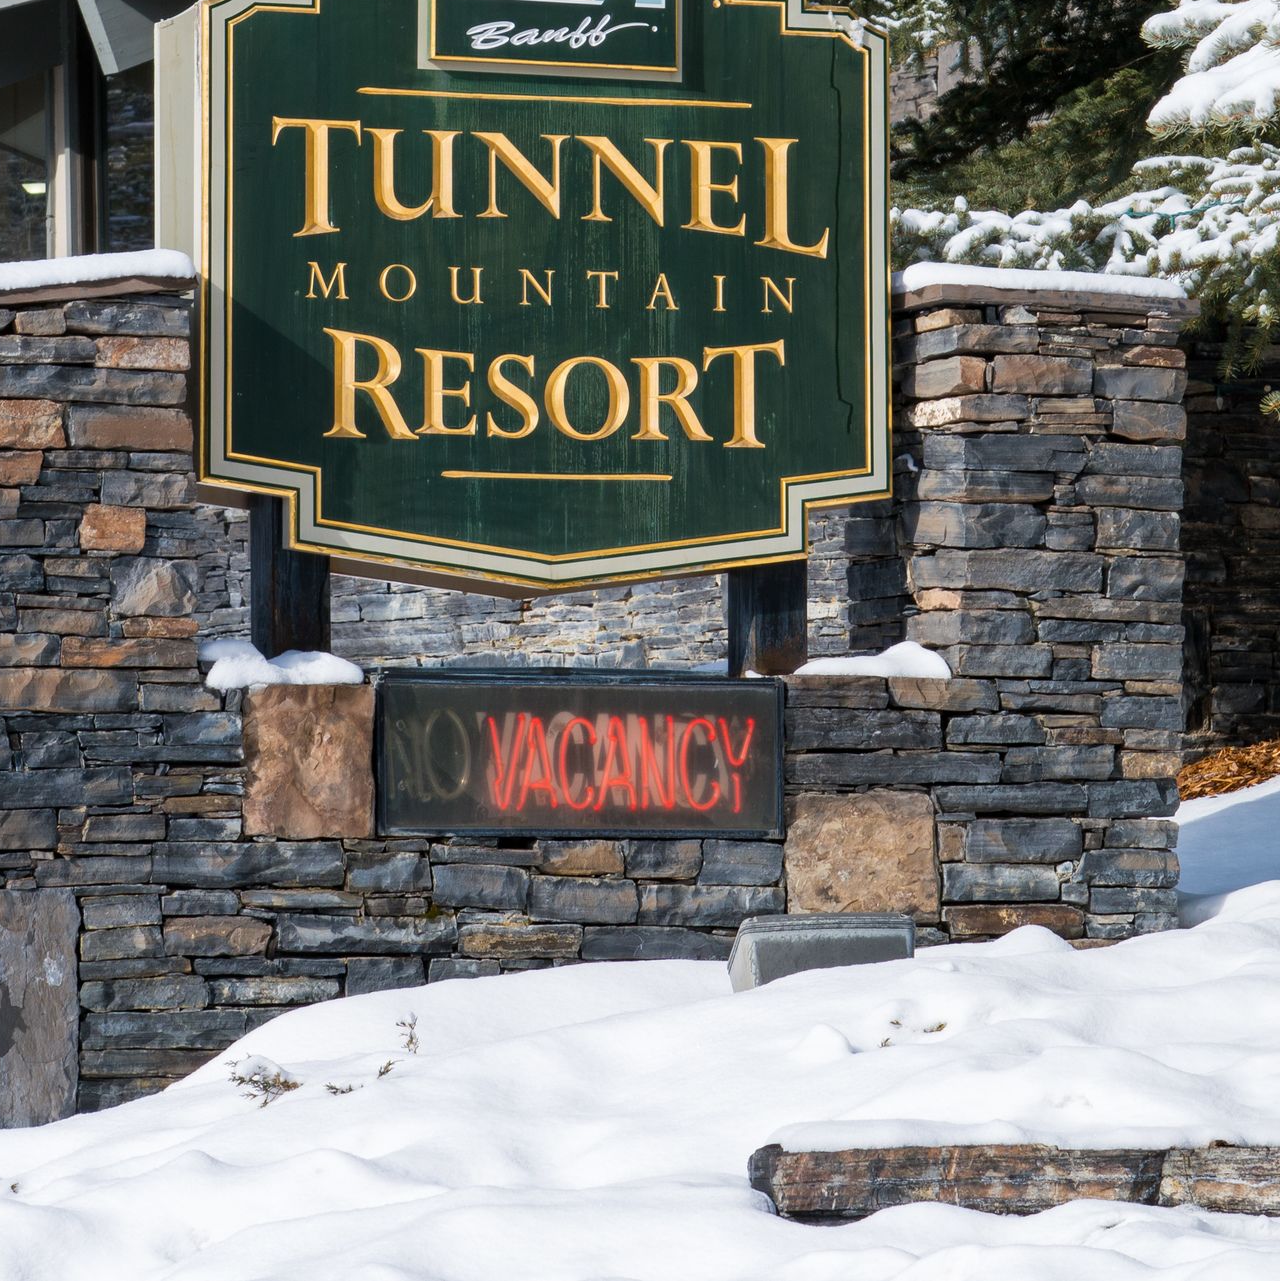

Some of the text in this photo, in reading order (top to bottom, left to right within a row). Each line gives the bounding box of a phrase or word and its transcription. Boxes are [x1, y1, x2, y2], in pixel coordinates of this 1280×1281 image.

[466, 14, 650, 50] Banff
[271, 115, 830, 260] TUNNEL
[304, 260, 798, 314] MOUNTAIN
[322, 326, 786, 449] RESORT
[486, 712, 756, 814] VACANCY
